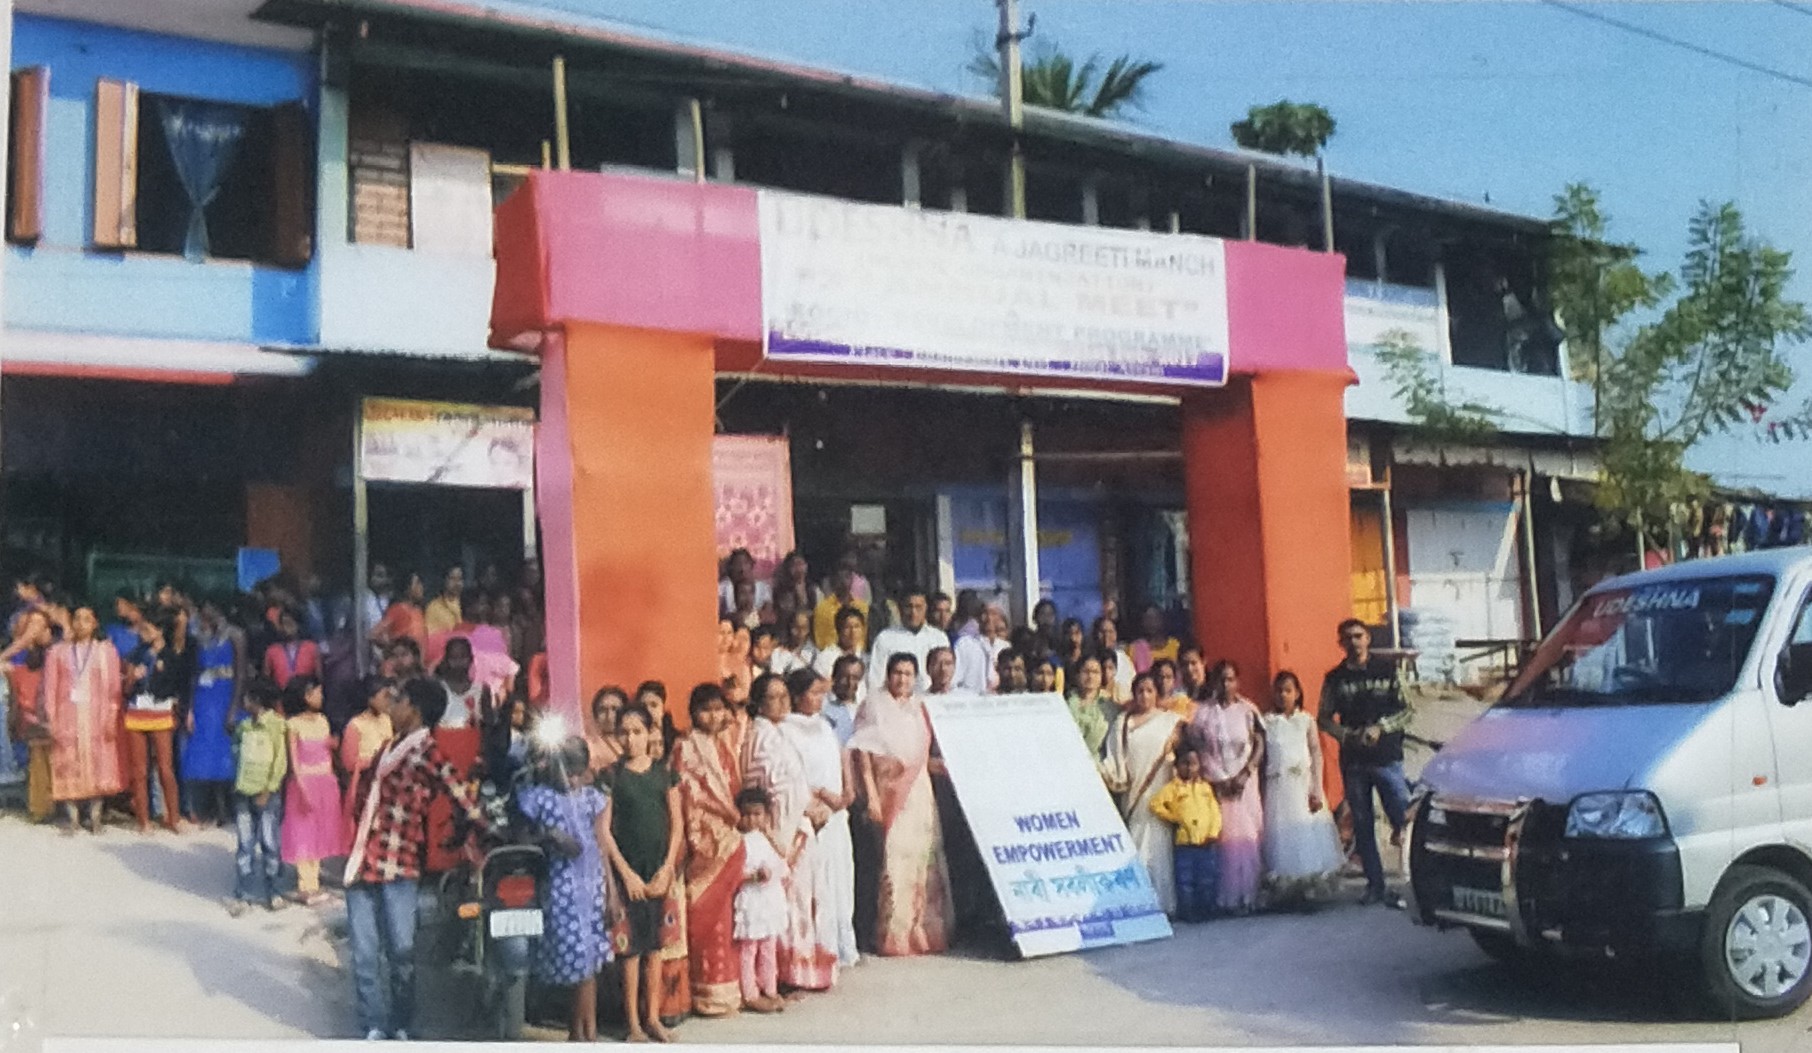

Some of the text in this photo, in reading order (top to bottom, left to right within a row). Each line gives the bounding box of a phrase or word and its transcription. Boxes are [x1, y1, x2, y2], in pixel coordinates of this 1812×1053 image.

[1014, 237, 1128, 268] JAGREETI
[1593, 589, 1701, 618] UDESHNA
[1013, 810, 1080, 832] WOMEN
[992, 834, 1124, 864] EMPOWERMENT
